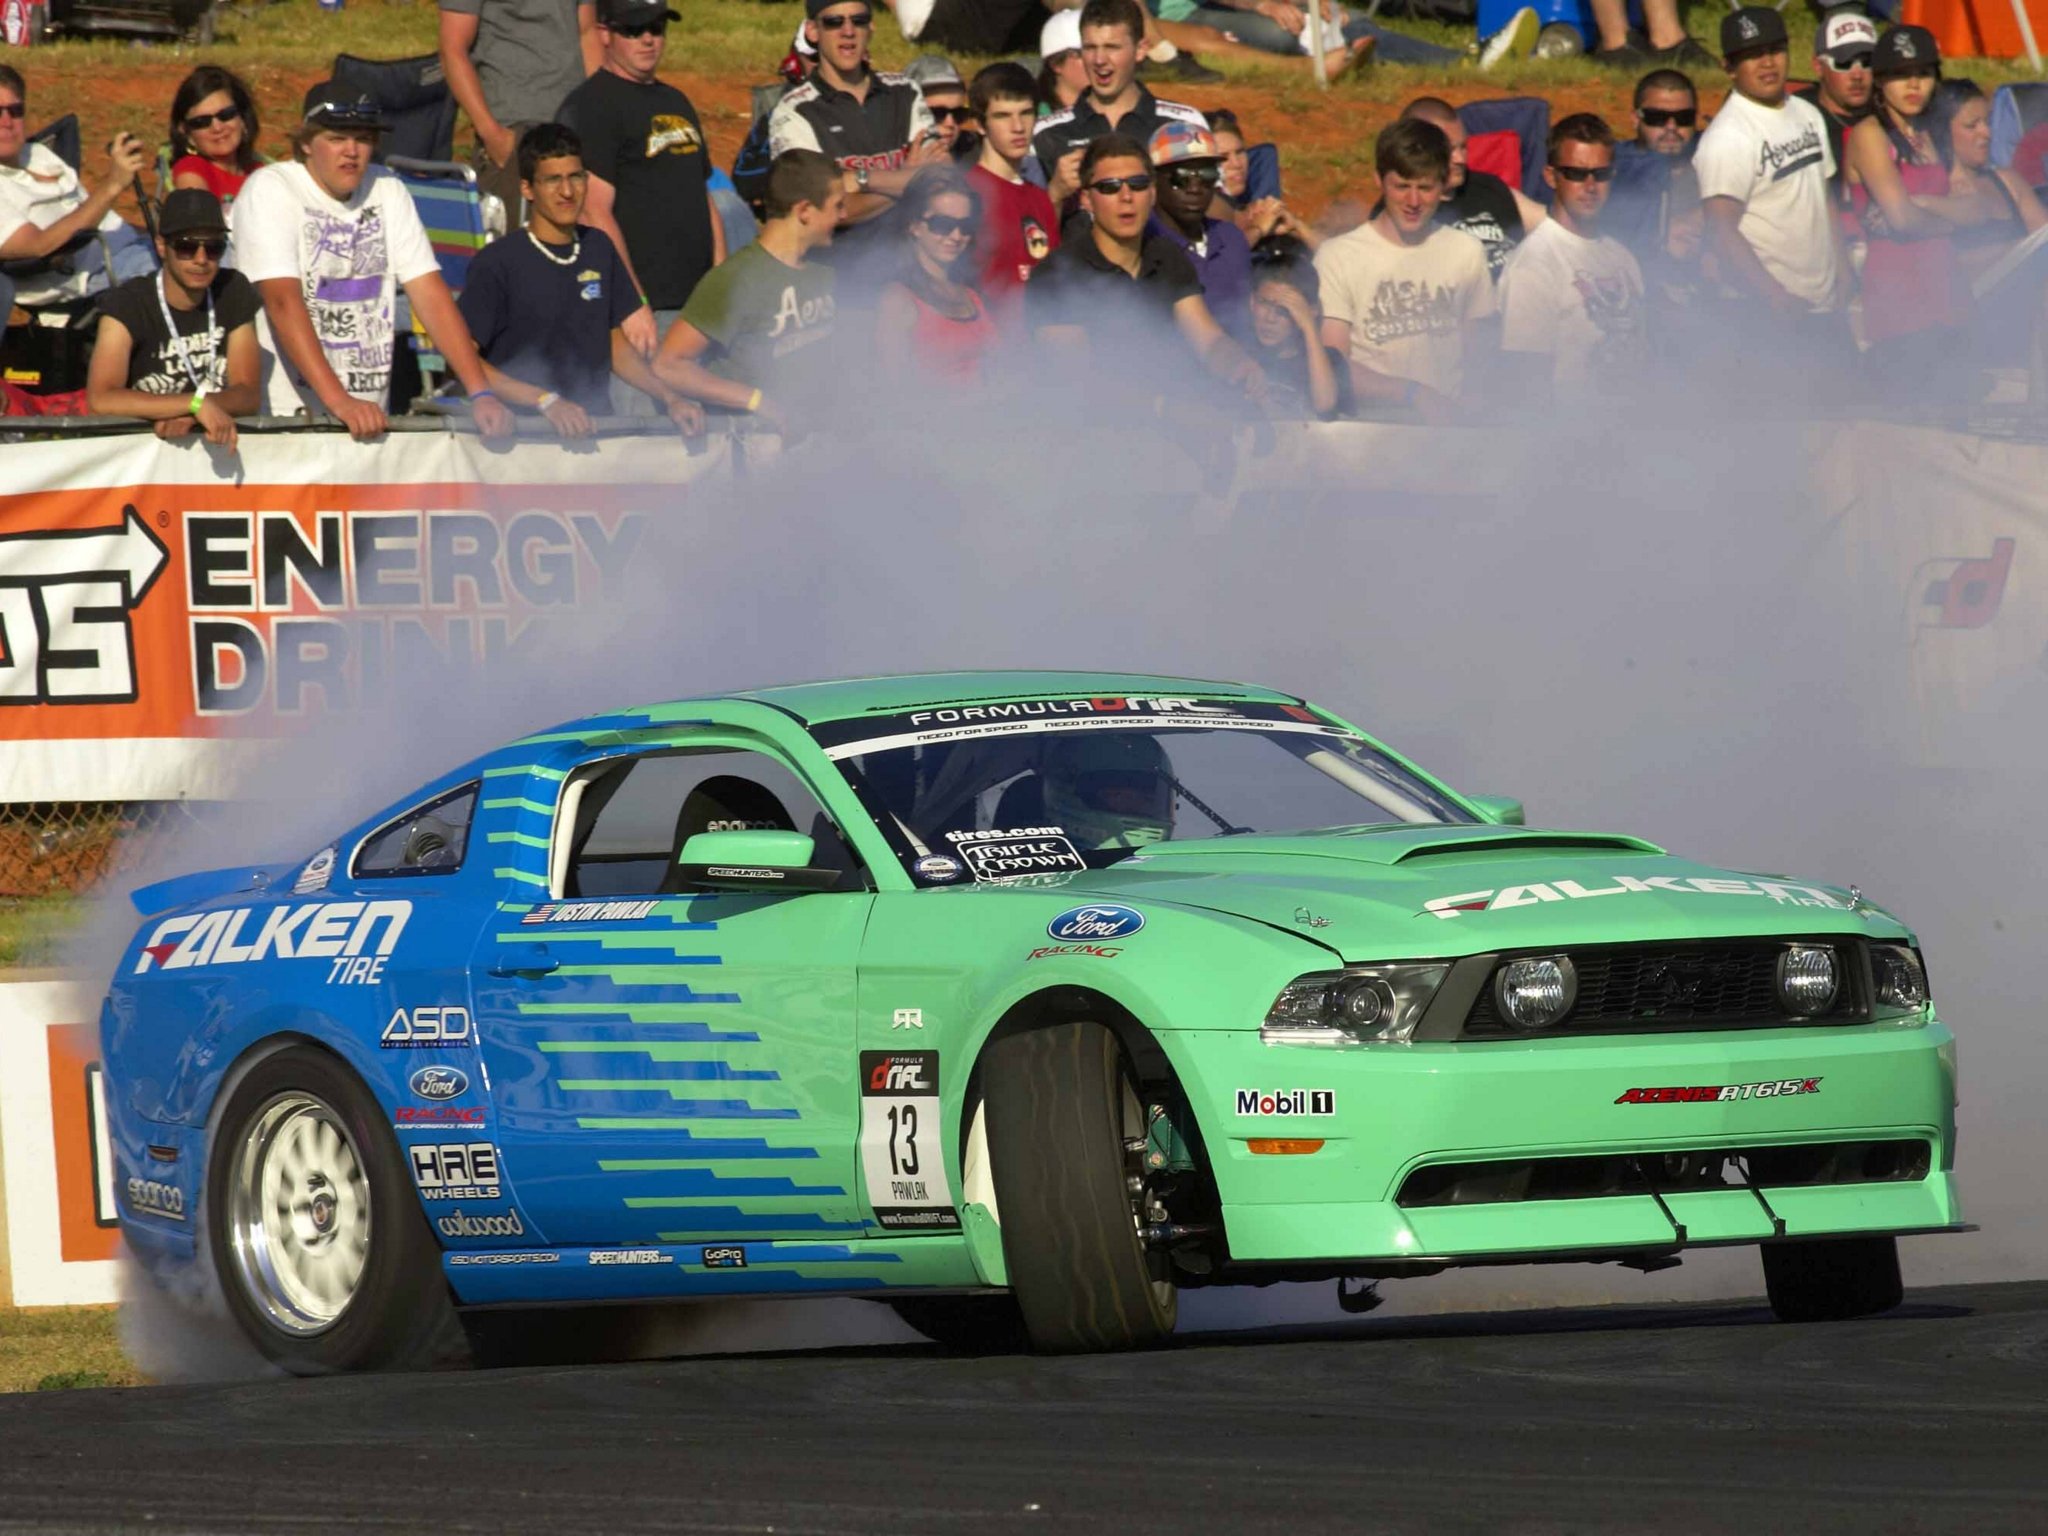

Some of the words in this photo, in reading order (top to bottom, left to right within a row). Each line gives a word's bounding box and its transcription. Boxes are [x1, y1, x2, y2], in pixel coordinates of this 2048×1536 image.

[182, 509, 650, 612] ENERGY
[911, 699, 1094, 726] FORMULA
[917, 731, 953, 741] NEED
[955, 728, 983, 736] FOR
[984, 724, 1029, 733] SPEED
[945, 826, 1065, 843] tires.com
[966, 842, 1061, 860] TRIPLE
[975, 852, 1078, 874] CROWN
[1422, 875, 1839, 920] FALKEN
[548, 902, 607, 922] JUSTIN
[1060, 905, 1130, 937] Ford
[133, 899, 413, 975] FALKEN
[1026, 944, 1124, 961] RACING
[326, 956, 389, 984] TIRE
[381, 1006, 470, 1040] ASD
[890, 1056, 924, 1064] FORMULA
[420, 1068, 459, 1096] Ford
[395, 1106, 488, 1122] RACING
[1237, 1090, 1305, 1115] Mobil
[457, 1122, 486, 1130] PARTS
[888, 1104, 919, 1175] 13
[412, 1147, 497, 1184] HRE
[421, 1186, 501, 1200] WHEELS
[438, 1207, 524, 1236] wilwood
[705, 1248, 742, 1260] GoPro
